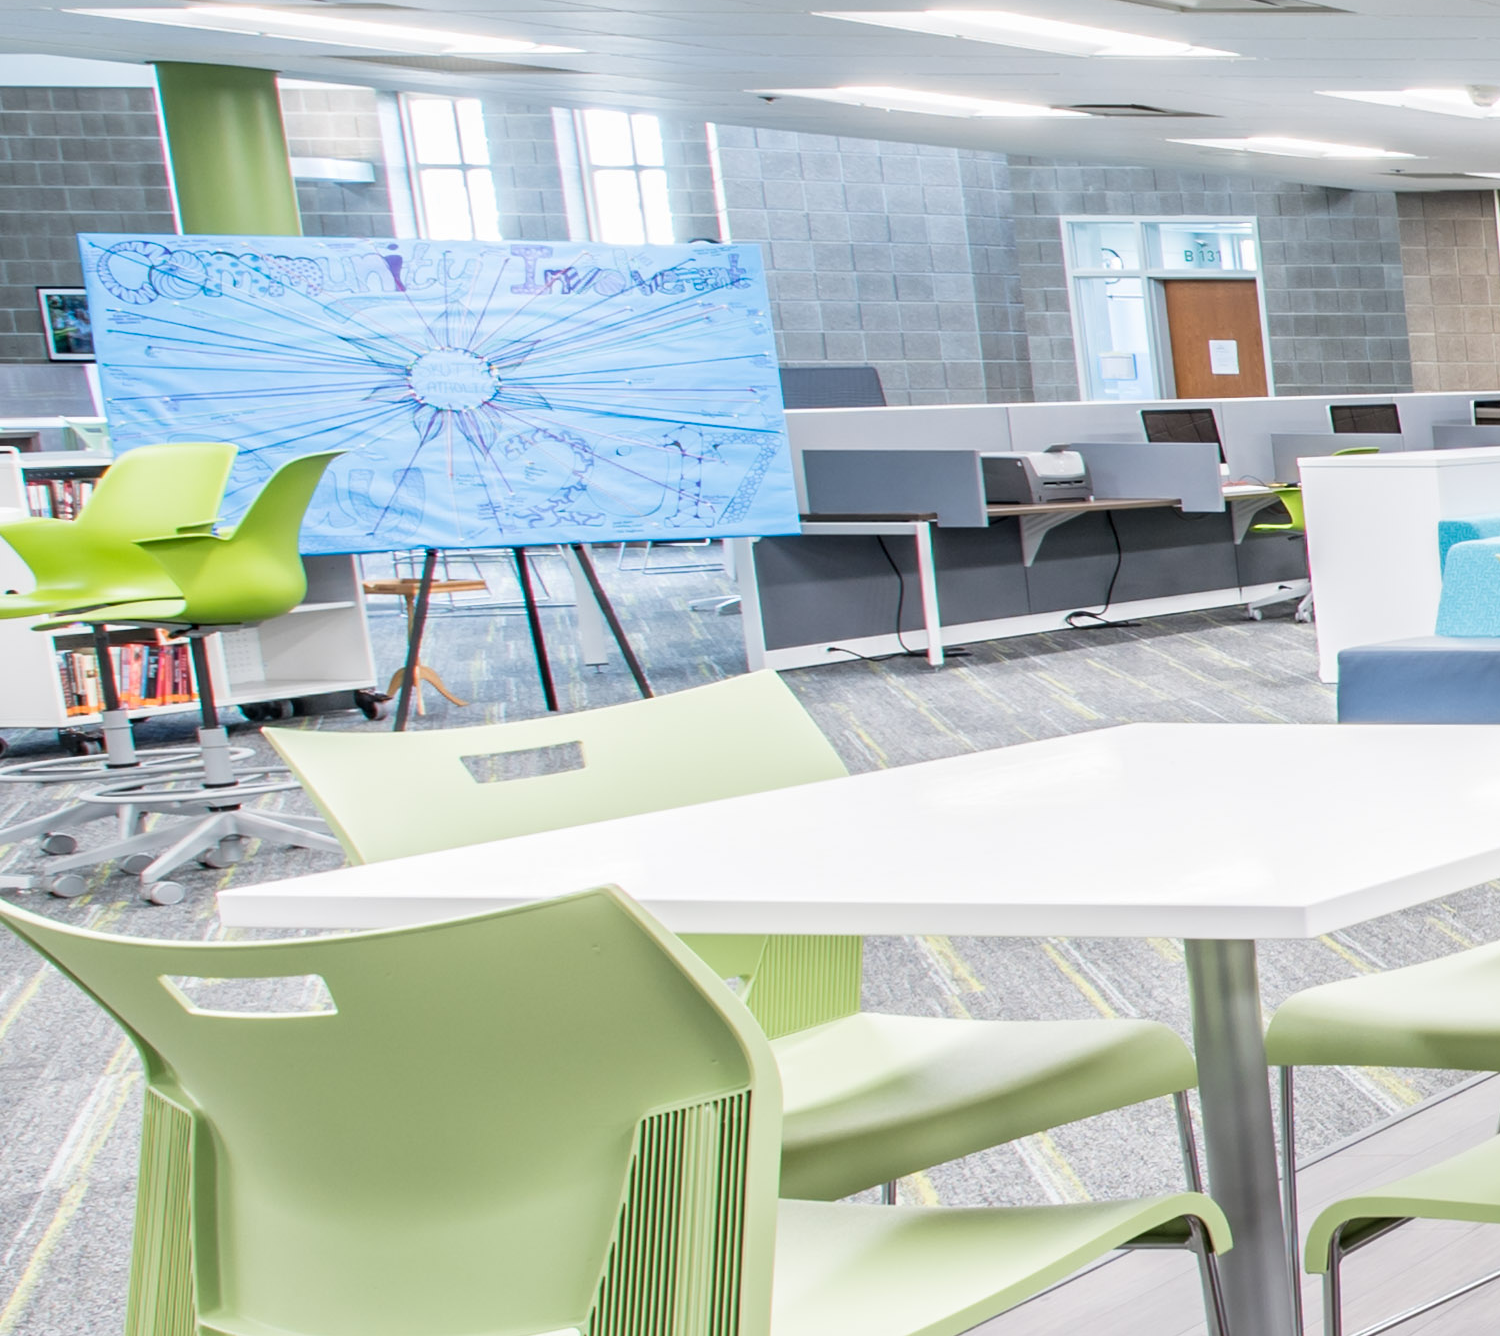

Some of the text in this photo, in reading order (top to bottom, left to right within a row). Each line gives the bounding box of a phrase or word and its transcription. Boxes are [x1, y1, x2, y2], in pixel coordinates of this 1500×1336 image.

[97, 240, 481, 321] Community
[1184, 250, 1222, 262] B 131
[497, 425, 784, 529] 2017
